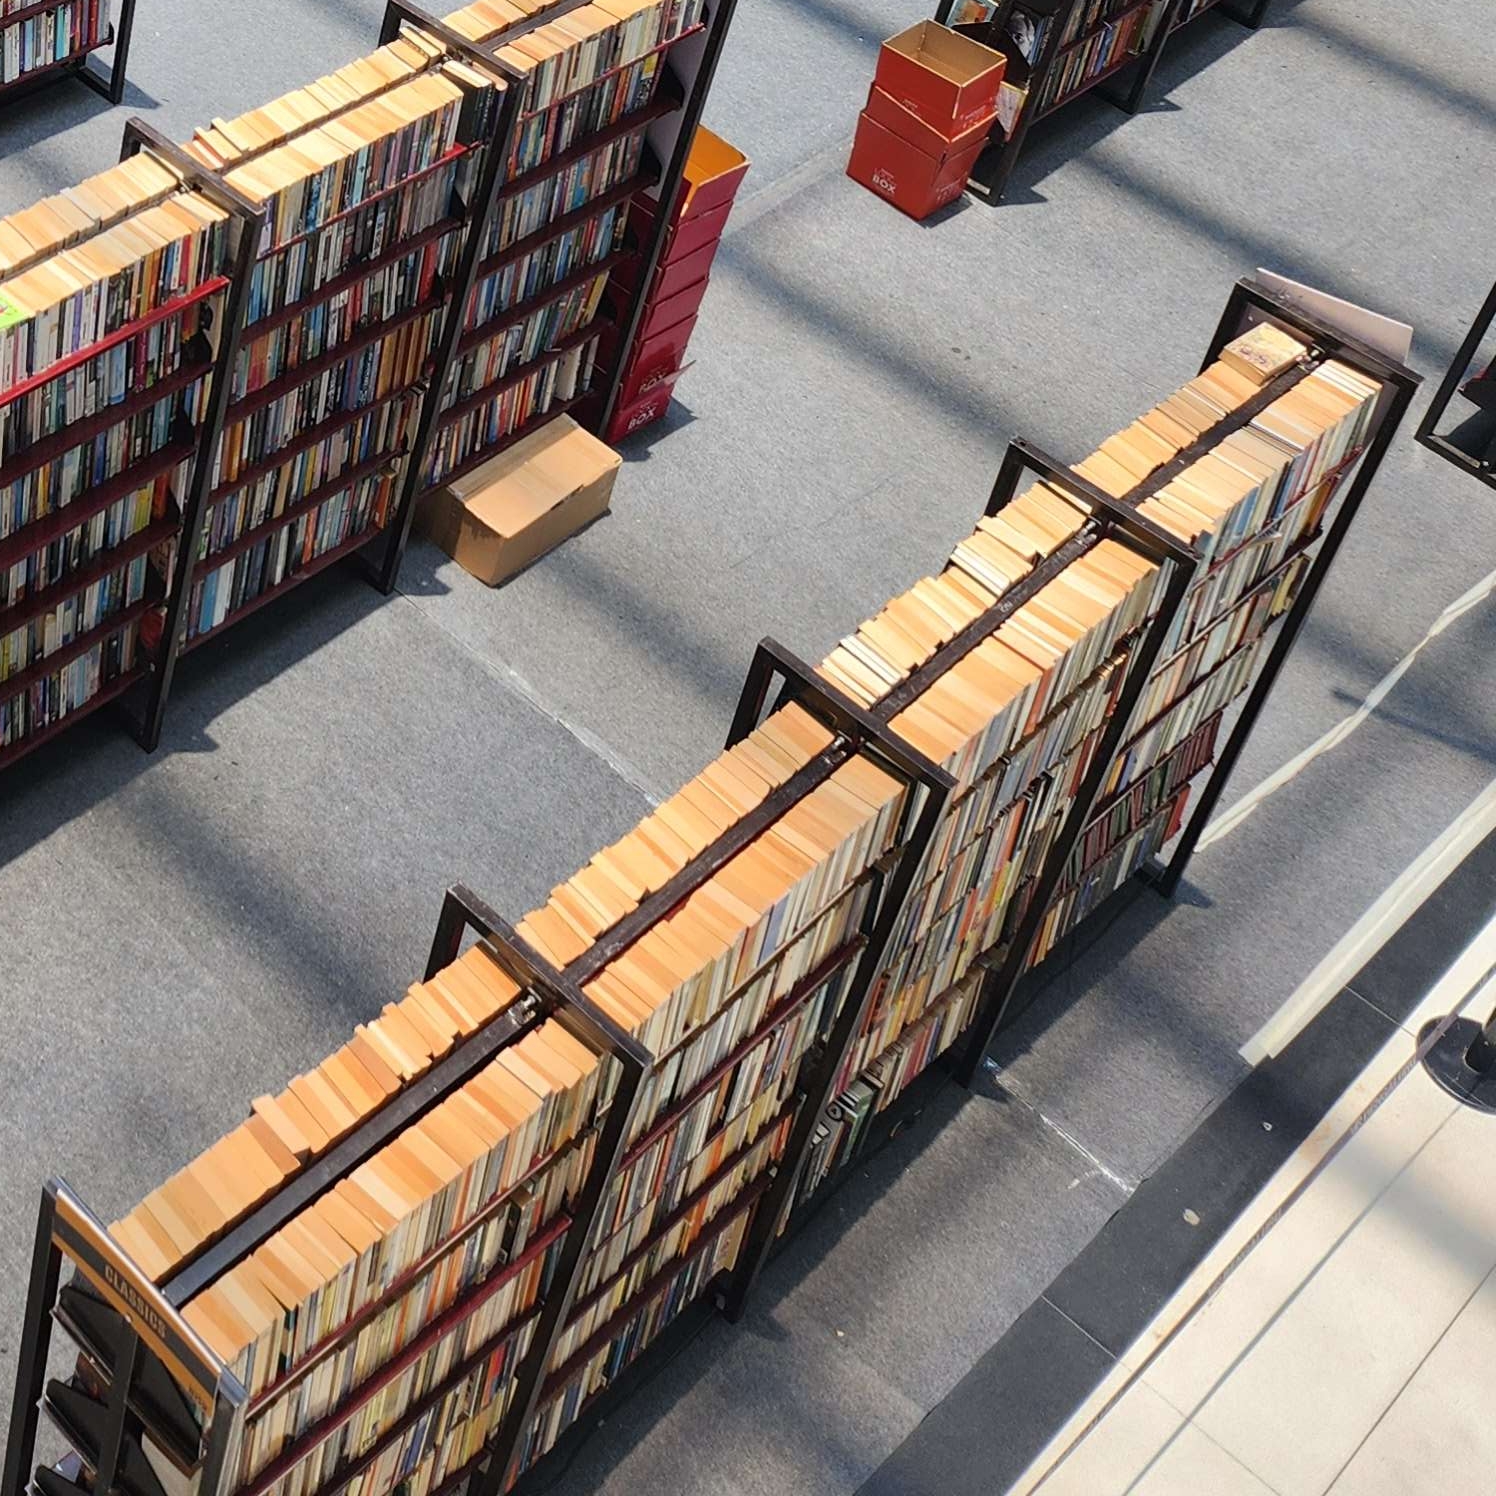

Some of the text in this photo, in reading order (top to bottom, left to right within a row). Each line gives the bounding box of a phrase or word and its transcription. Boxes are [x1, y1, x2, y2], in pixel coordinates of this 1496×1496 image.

[871, 174, 897, 194] BOX
[627, 407, 657, 430] BOX
[104, 1263, 167, 1339] CLASSICS
